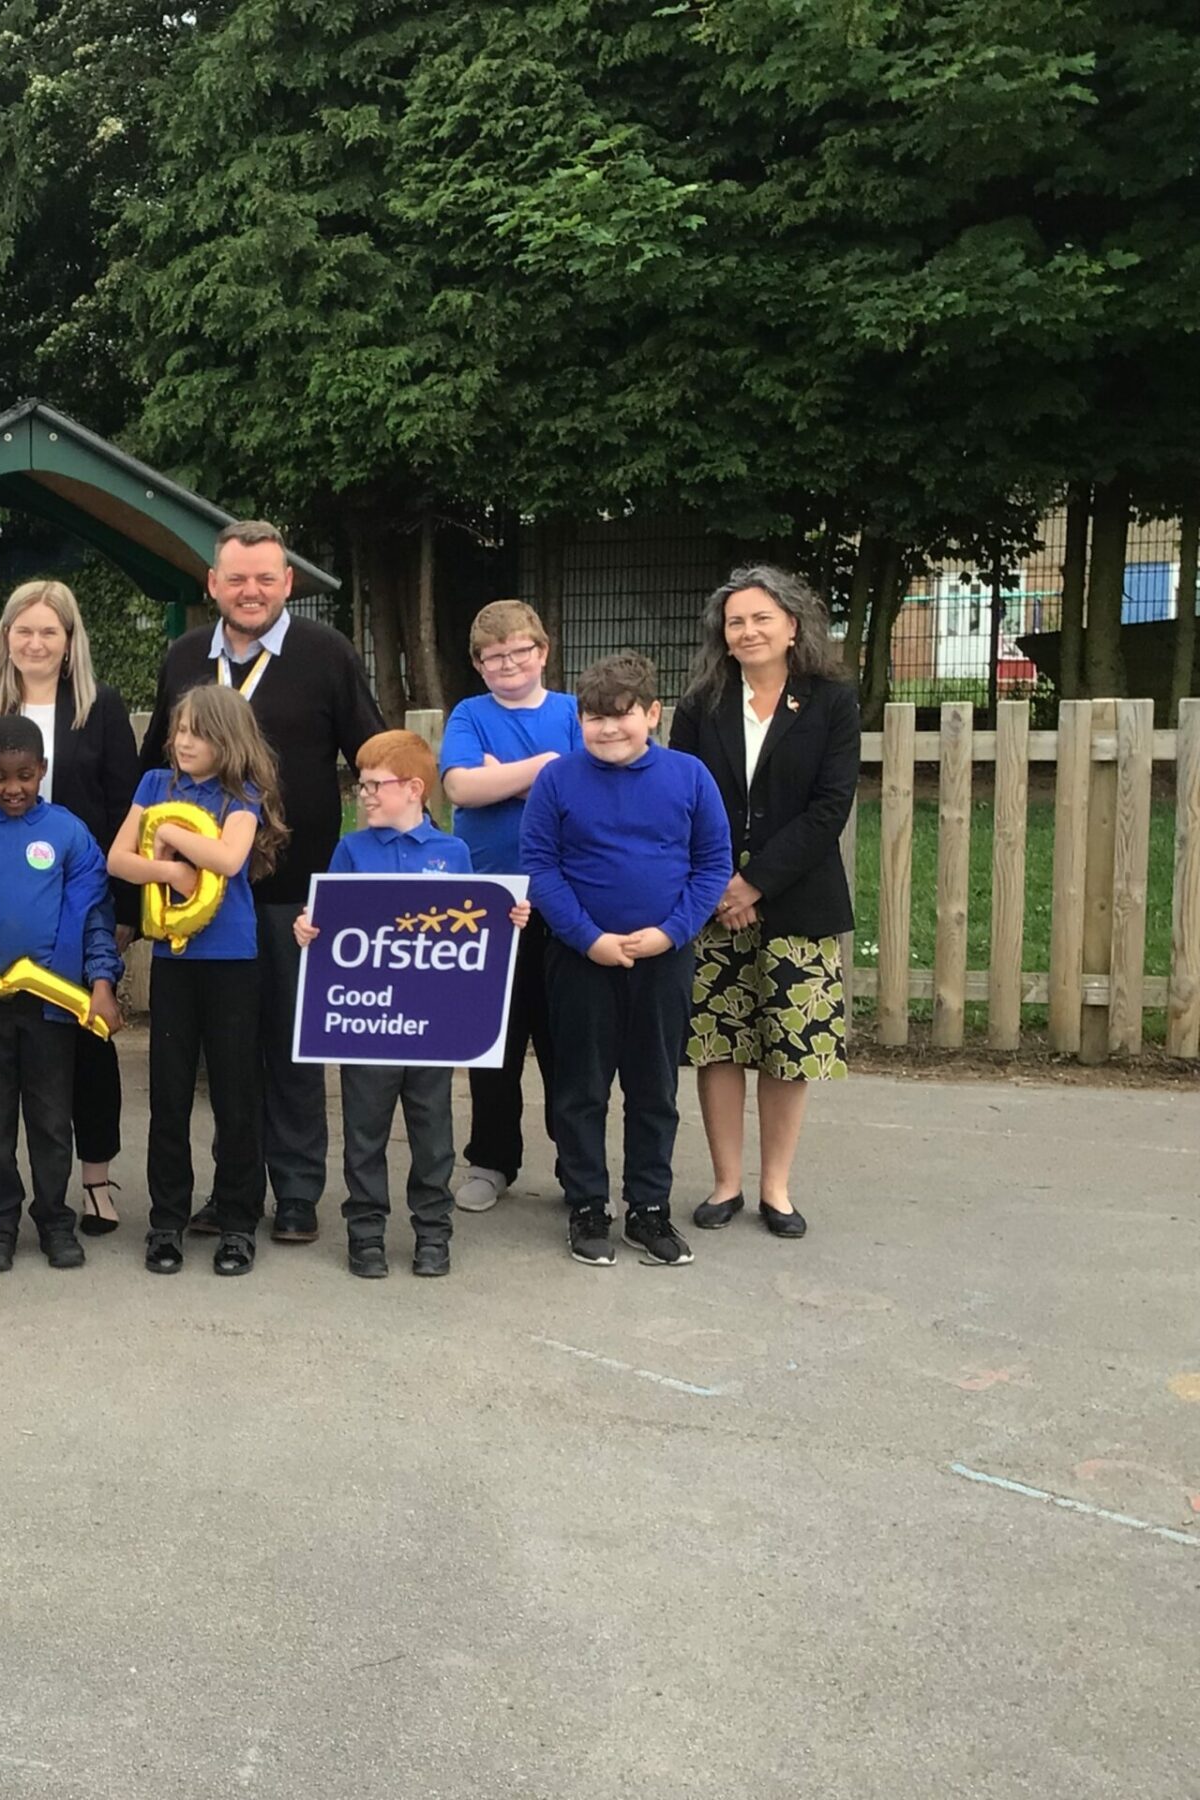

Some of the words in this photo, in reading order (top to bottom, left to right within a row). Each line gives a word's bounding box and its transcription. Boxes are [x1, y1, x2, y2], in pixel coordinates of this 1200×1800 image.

[331, 925, 490, 971] Ofsted
[327, 984, 393, 1007] Good
[324, 1011, 429, 1036] Provider
